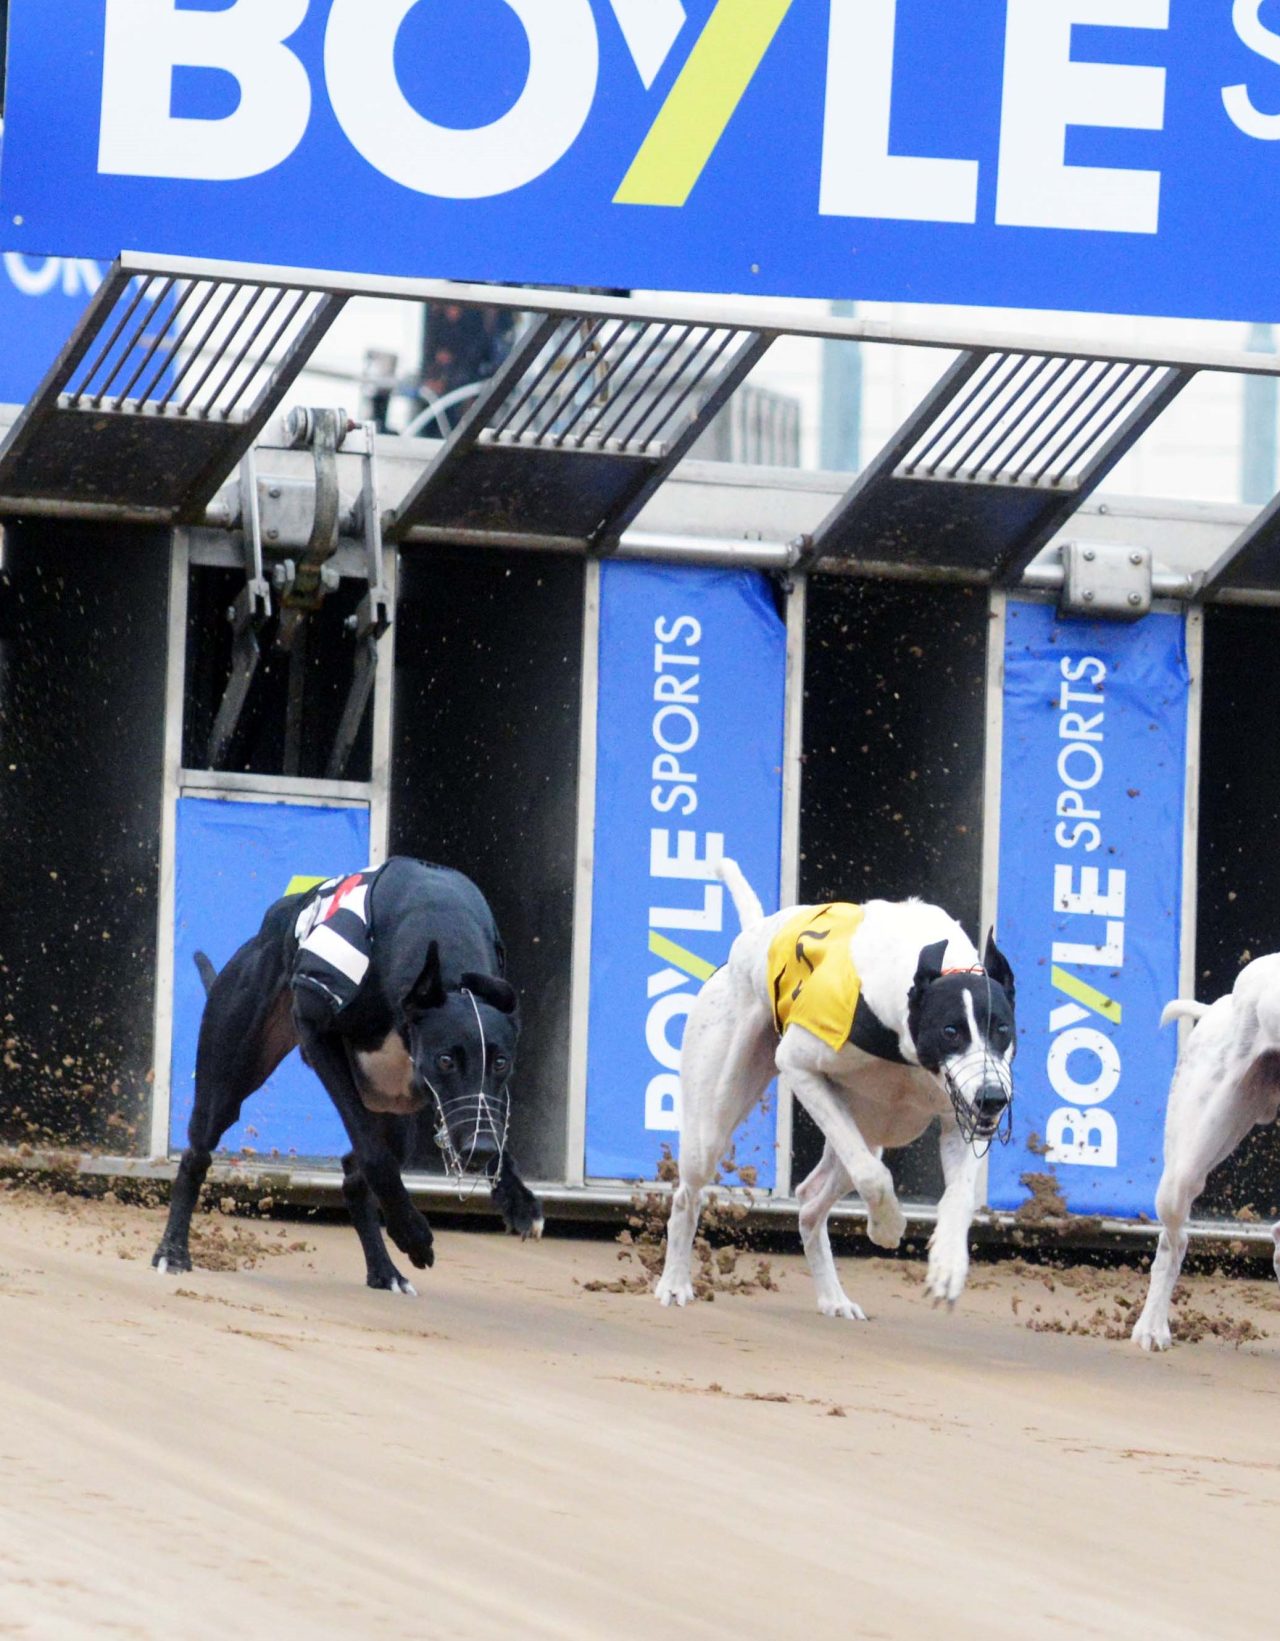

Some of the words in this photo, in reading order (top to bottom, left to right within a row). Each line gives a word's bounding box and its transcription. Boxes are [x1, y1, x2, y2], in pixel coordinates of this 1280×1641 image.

[98, 0, 1170, 234] BOYLE
[650, 614, 702, 816] SPORTS
[1055, 655, 1107, 853] SPORTS
[1045, 864, 1127, 1168] BOYLE
